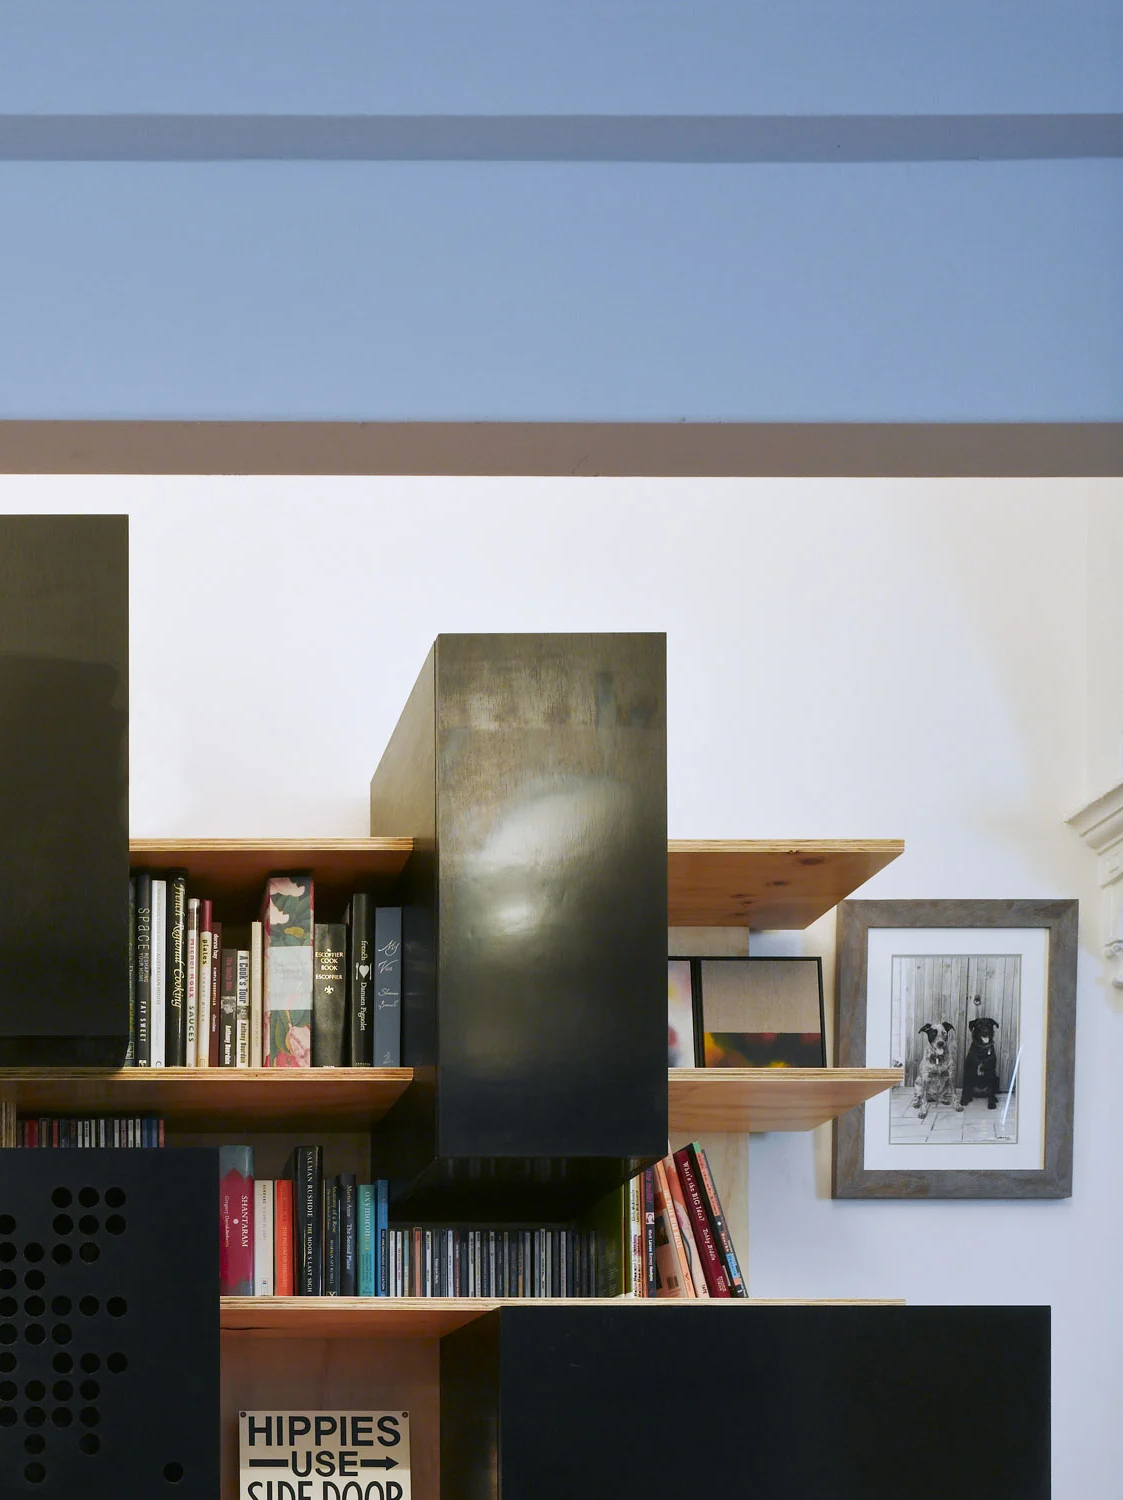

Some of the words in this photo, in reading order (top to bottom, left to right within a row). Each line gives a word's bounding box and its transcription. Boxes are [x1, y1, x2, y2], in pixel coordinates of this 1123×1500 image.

[172, 968, 184, 1008] Cooking
[239, 963, 248, 986] Cook's
[239, 989, 247, 1004] Tour
[358, 1007, 368, 1031] Pignolet
[682, 1160, 693, 1181] What's
[692, 1192, 702, 1206] BIG
[241, 1195, 249, 1247] SHANTARAM
[248, 1416, 401, 1447] HIPPIES
[291, 1451, 359, 1478] USE
